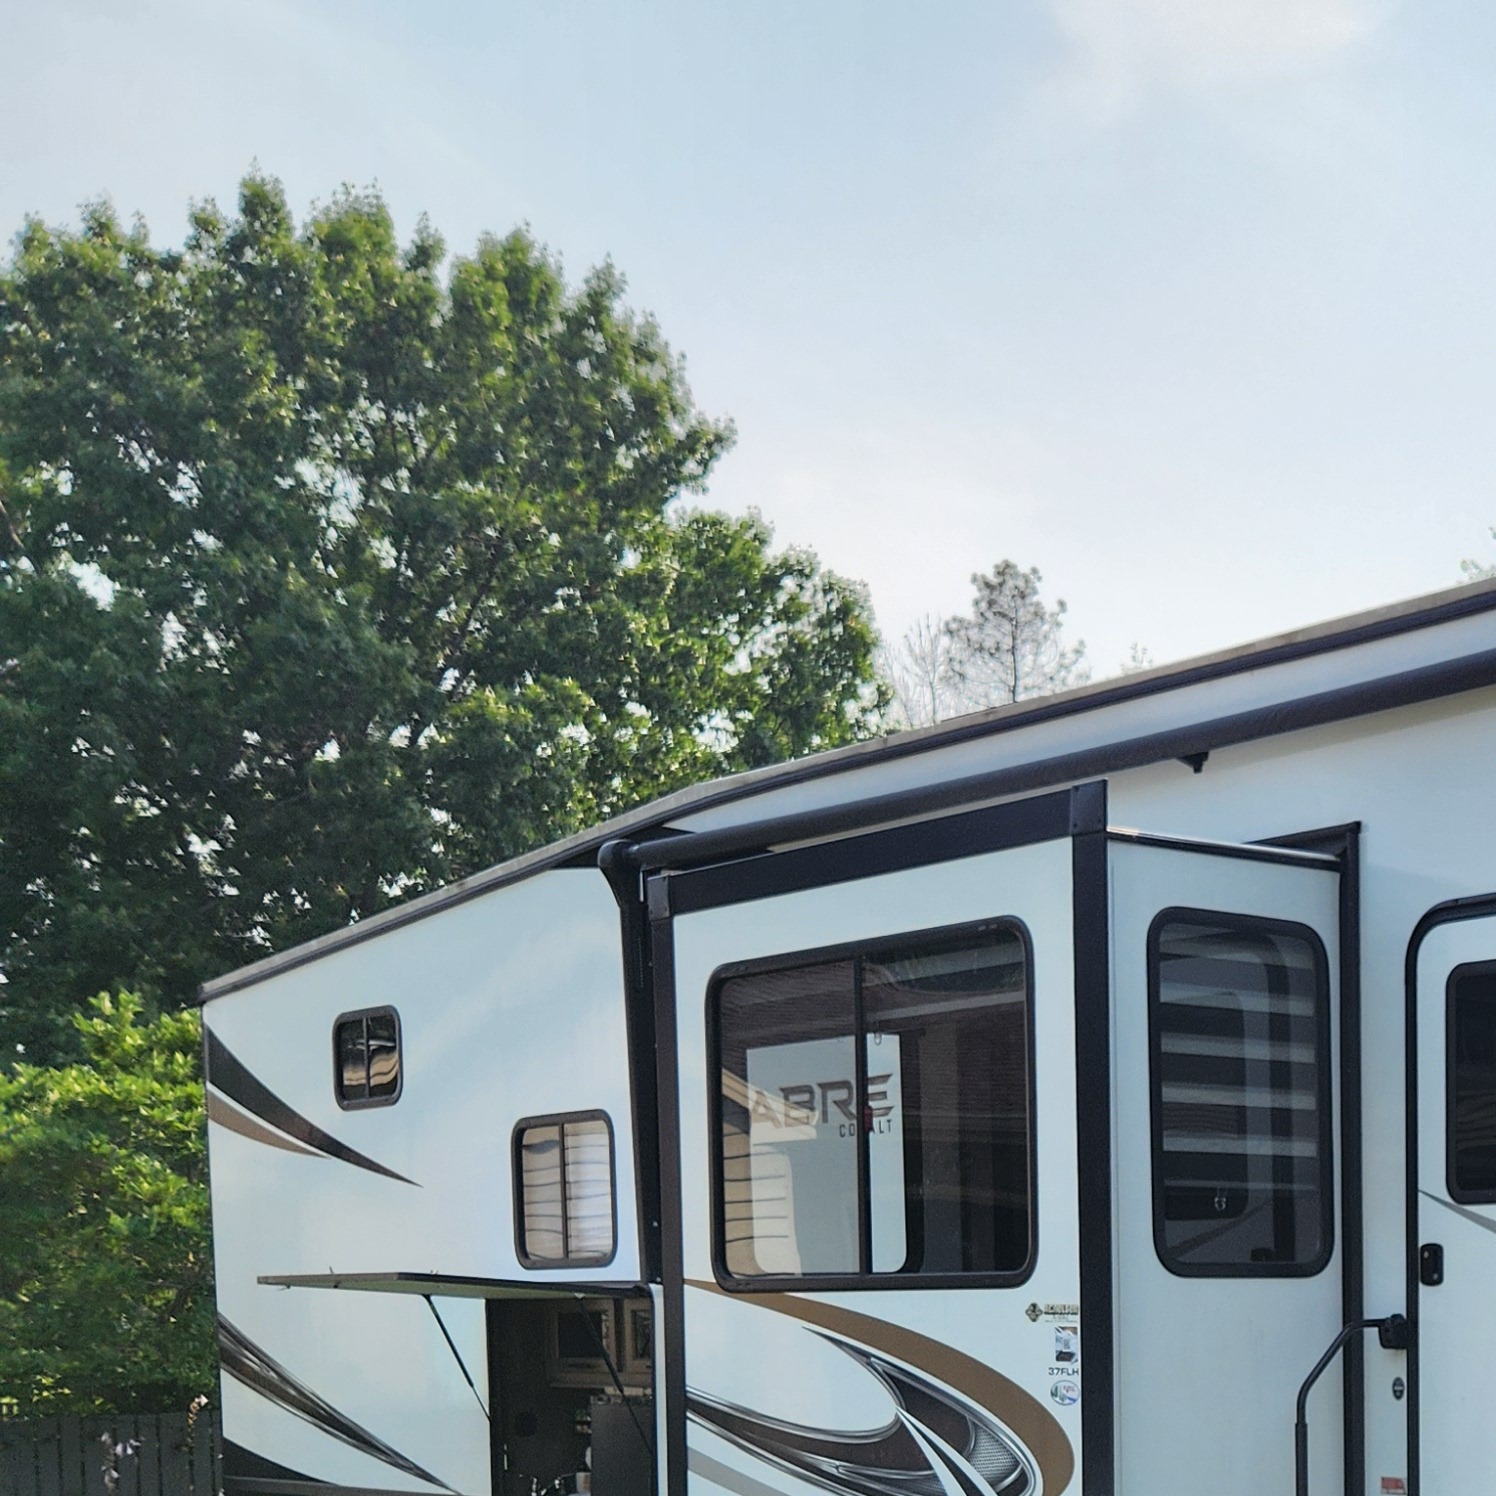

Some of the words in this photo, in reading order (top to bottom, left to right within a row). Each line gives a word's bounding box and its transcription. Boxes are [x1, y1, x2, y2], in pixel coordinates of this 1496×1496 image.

[750, 1073, 895, 1128] ABRE
[839, 1119, 893, 1138] COLT
[1048, 1367, 1079, 1376] 37FLH
